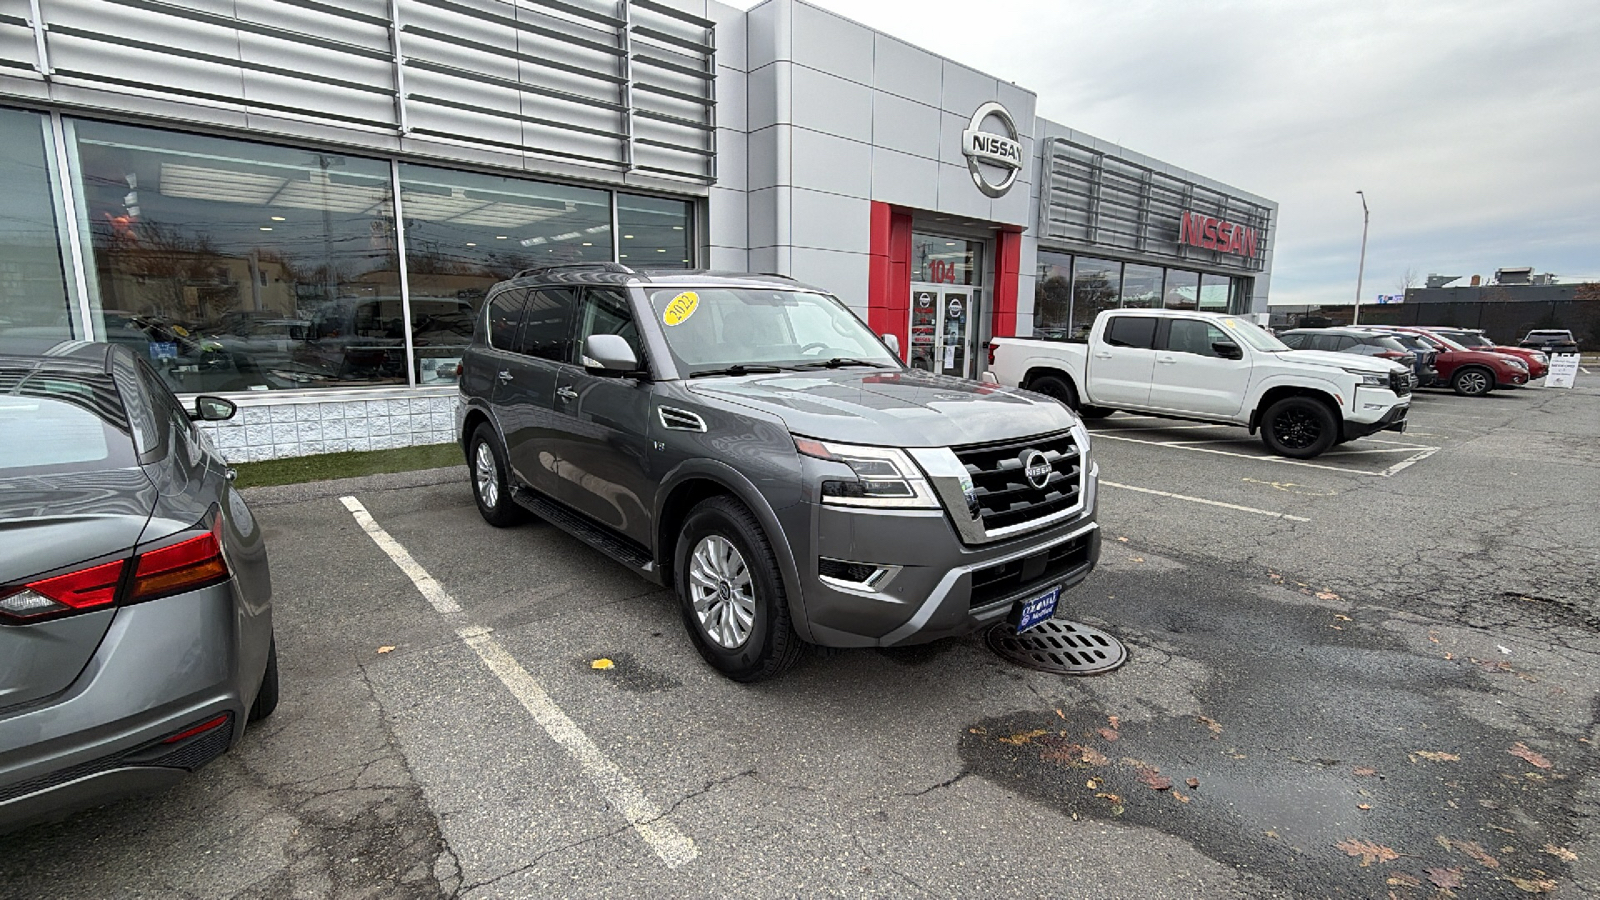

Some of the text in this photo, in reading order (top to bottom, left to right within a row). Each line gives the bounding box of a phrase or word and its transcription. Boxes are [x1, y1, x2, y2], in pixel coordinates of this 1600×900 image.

[973, 135, 1021, 162] NISSAN
[1181, 210, 1257, 258] NISSAN
[928, 259, 956, 285] 104
[669, 294, 694, 321] 2022
